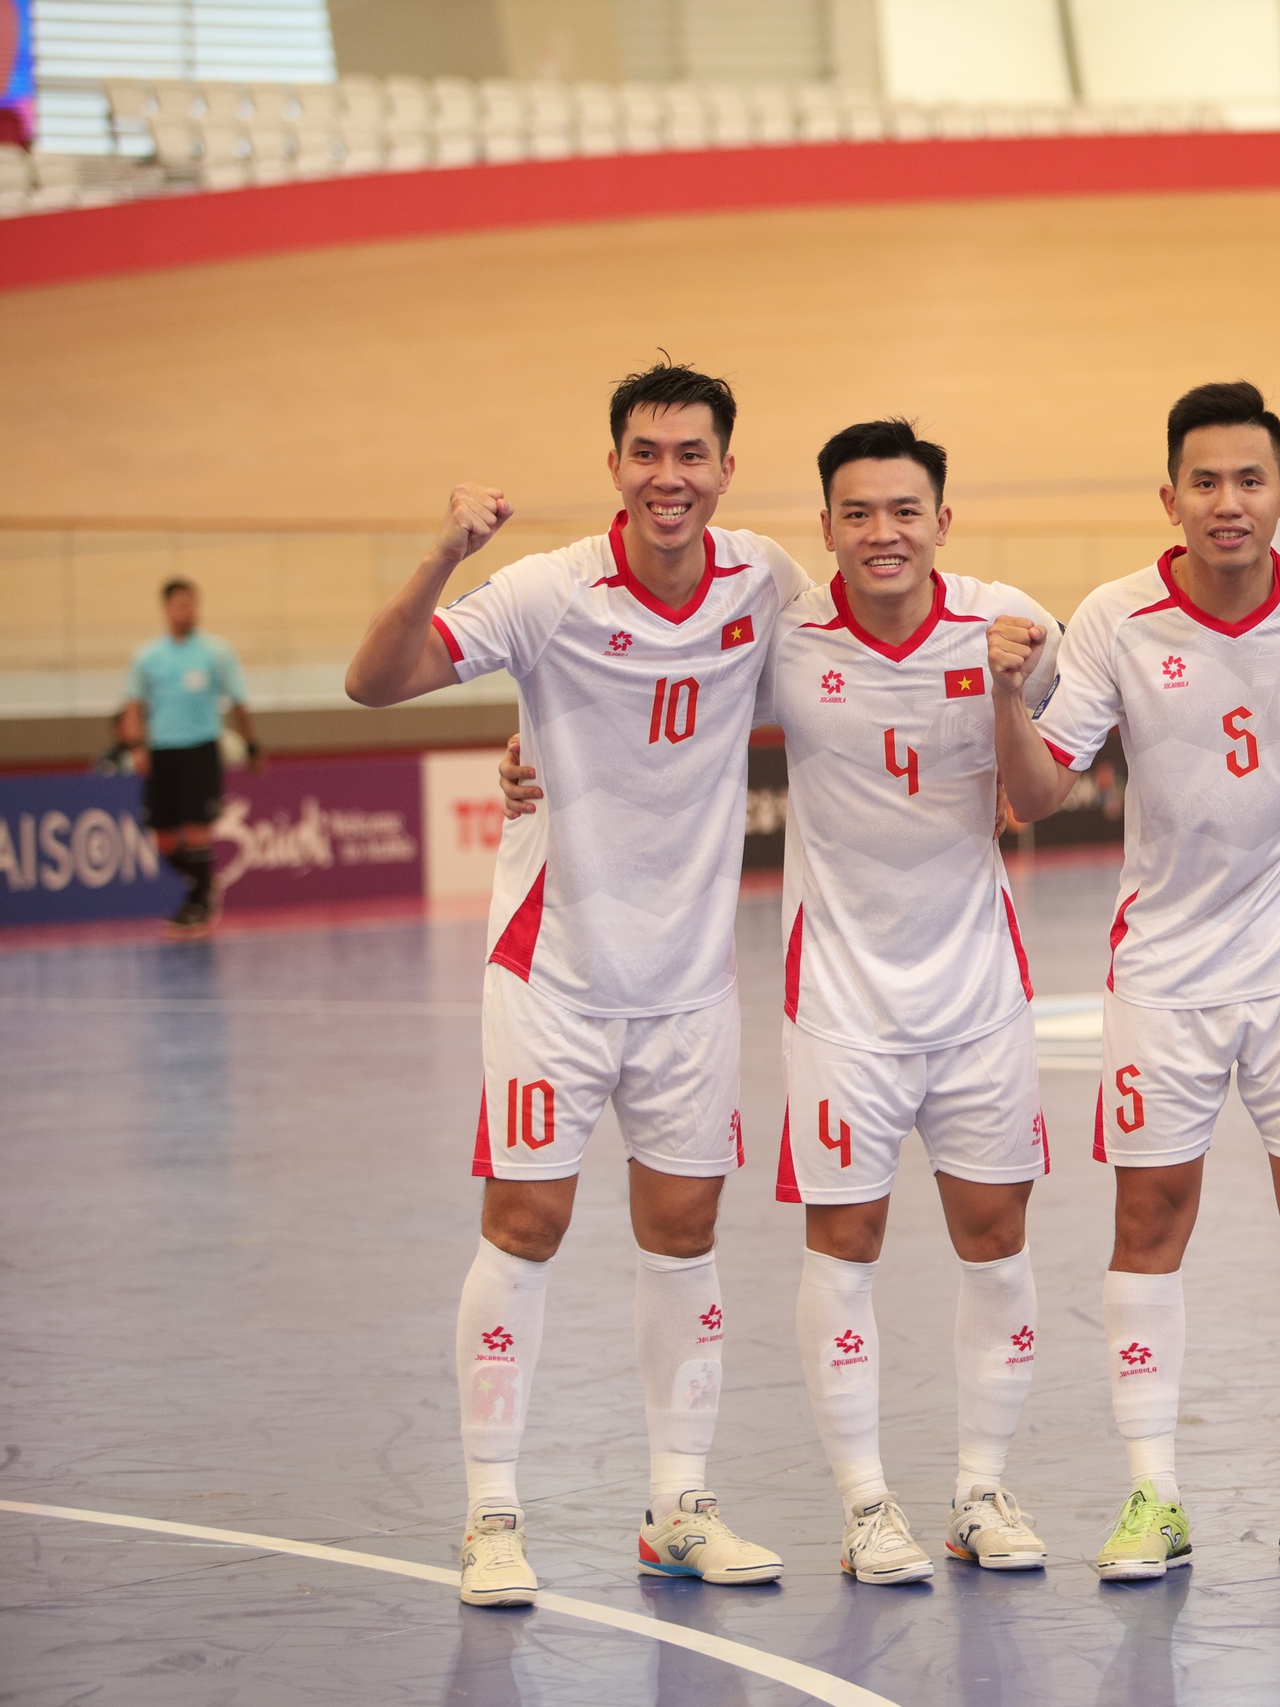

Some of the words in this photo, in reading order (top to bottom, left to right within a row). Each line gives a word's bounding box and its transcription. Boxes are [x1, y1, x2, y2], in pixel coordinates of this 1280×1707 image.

[648, 676, 700, 745] 10
[883, 727, 921, 796] 4
[507, 1077, 555, 1151] 10
[818, 1098, 853, 1169] 4
